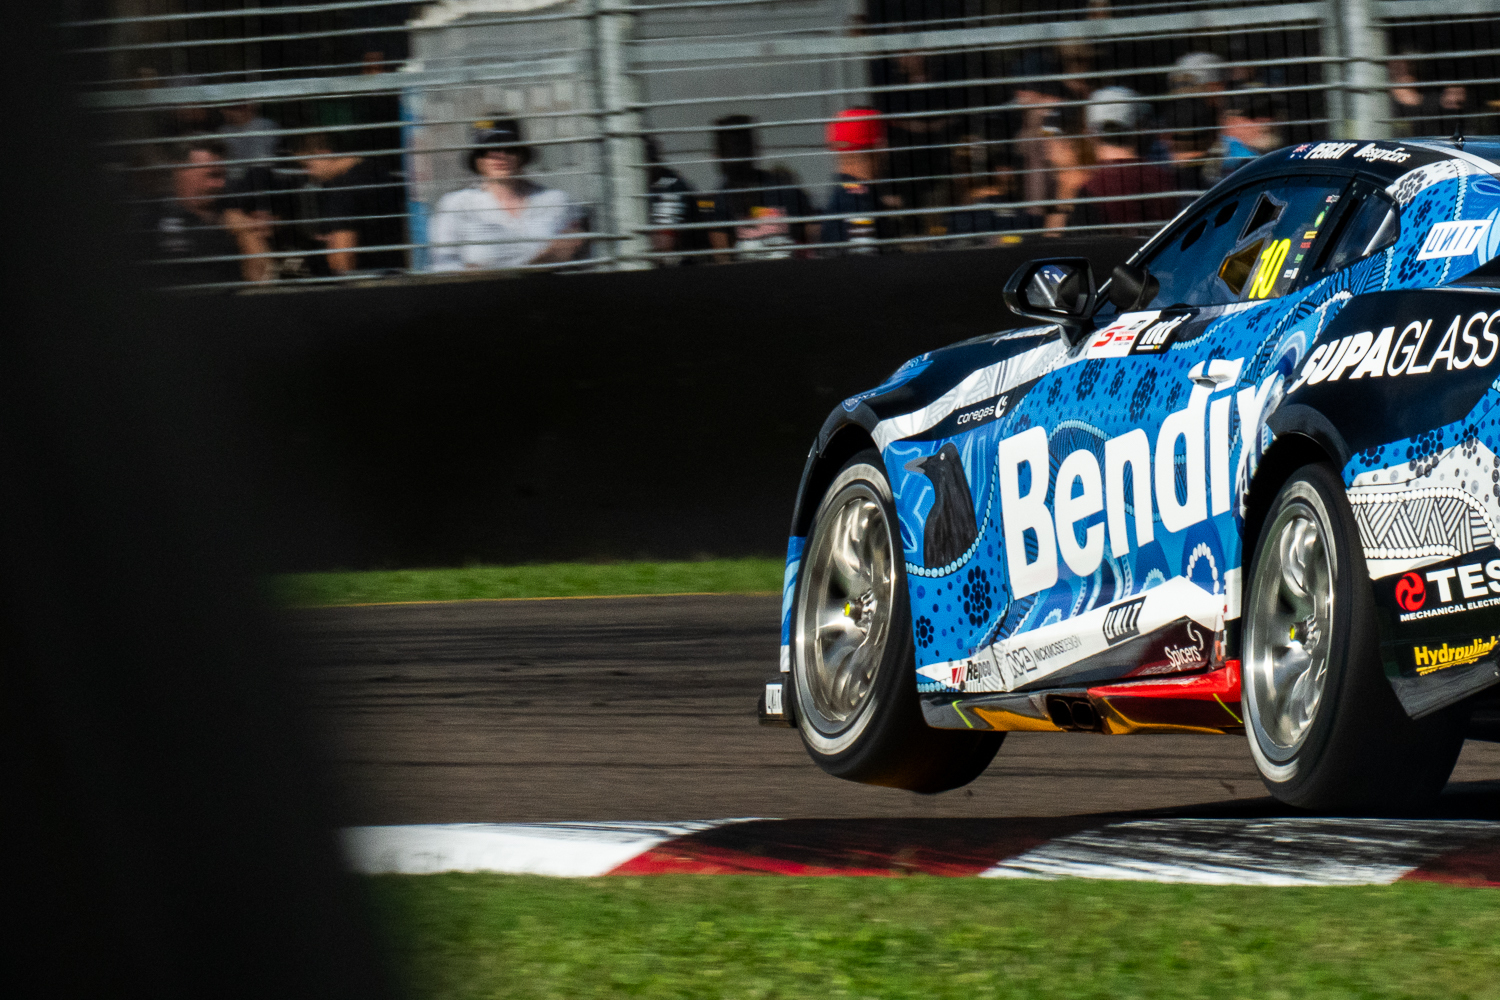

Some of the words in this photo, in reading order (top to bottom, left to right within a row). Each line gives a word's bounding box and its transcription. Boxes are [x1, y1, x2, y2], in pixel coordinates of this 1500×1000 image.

[1425, 225, 1483, 253] UNIT
[1248, 238, 1291, 299] 10
[957, 405, 995, 425] coregas
[1104, 602, 1142, 640] UNIT
[1400, 603, 1466, 622] MECHANICAL
[1164, 644, 1201, 671] Spicers
[1414, 635, 1499, 666] Hydraulink
[965, 660, 992, 683] Repco
